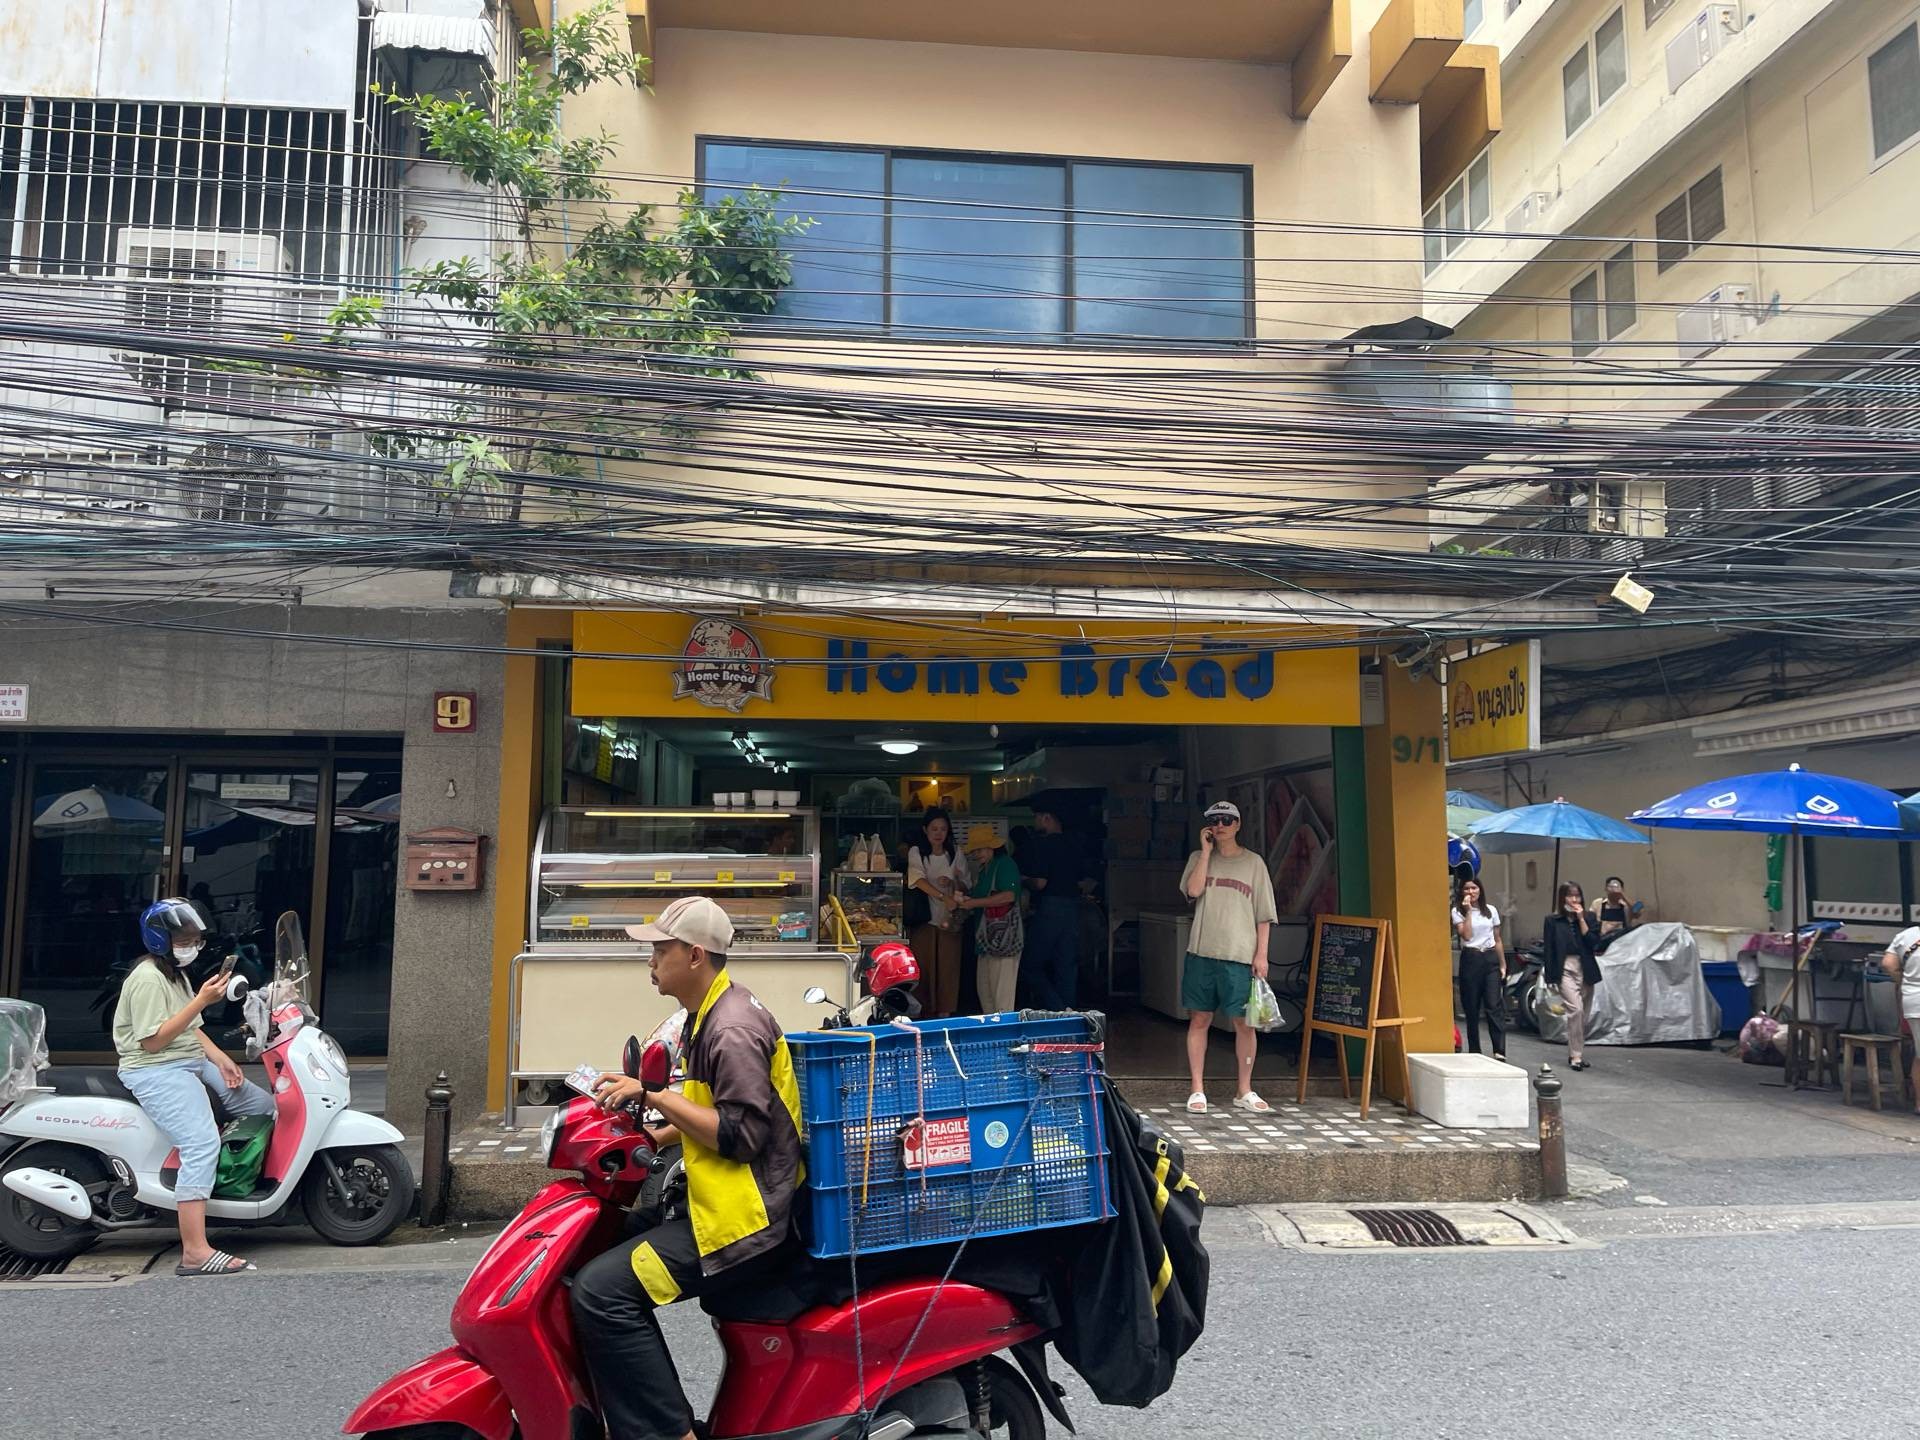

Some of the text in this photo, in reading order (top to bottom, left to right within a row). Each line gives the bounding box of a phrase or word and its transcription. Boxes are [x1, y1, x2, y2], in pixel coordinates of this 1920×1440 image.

[687, 671, 756, 684] Home Bread
[827, 638, 1275, 700] Home Bread
[437, 695, 472, 729] 9
[1392, 735, 1440, 764] 9/1
[35, 1115, 89, 1125] SCOOPY
[926, 1120, 969, 1137] FRAGILE
